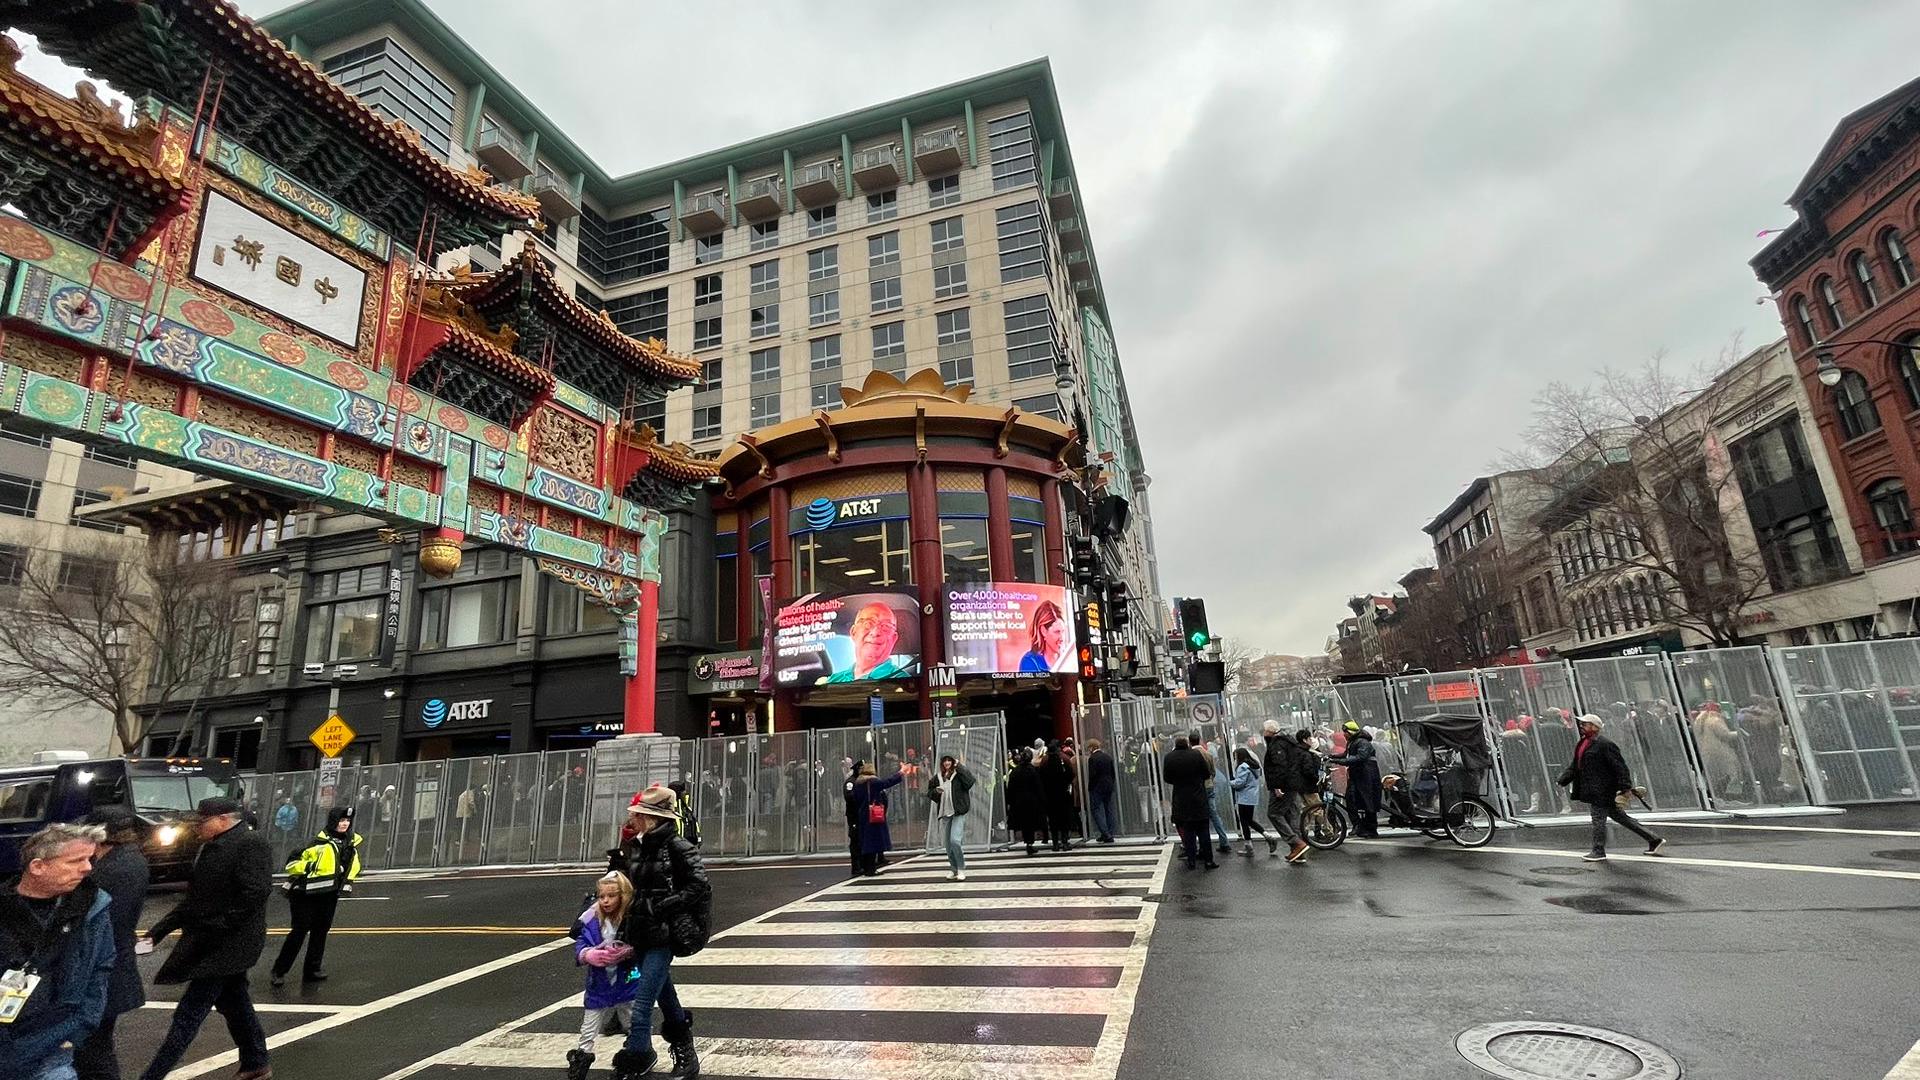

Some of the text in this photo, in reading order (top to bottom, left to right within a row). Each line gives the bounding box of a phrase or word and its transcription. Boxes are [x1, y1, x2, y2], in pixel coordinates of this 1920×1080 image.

[840, 499, 881, 518] AT&T
[949, 591, 1038, 601] Over 4,000 healthcare
[806, 602, 815, 611] of
[815, 599, 845, 611] health-
[950, 601, 1007, 611] organizations
[779, 611, 837, 626] related trips are
[977, 612, 992, 620] use
[993, 611, 1013, 620] Uber
[1014, 611, 1023, 620] to
[779, 622, 832, 636] made by Uber
[951, 621, 1026, 632] support their local
[779, 631, 836, 646] drivers like Tom
[951, 631, 1008, 641] communities
[778, 642, 825, 656] every month
[1622, 646, 1644, 656] CHOPT
[952, 656, 978, 667] Uber
[778, 670, 799, 682] Uber
[939, 667, 956, 686] M
[1084, 665, 1094, 677] 14
[446, 699, 494, 722] AT&T
[322, 772, 337, 782] 25
